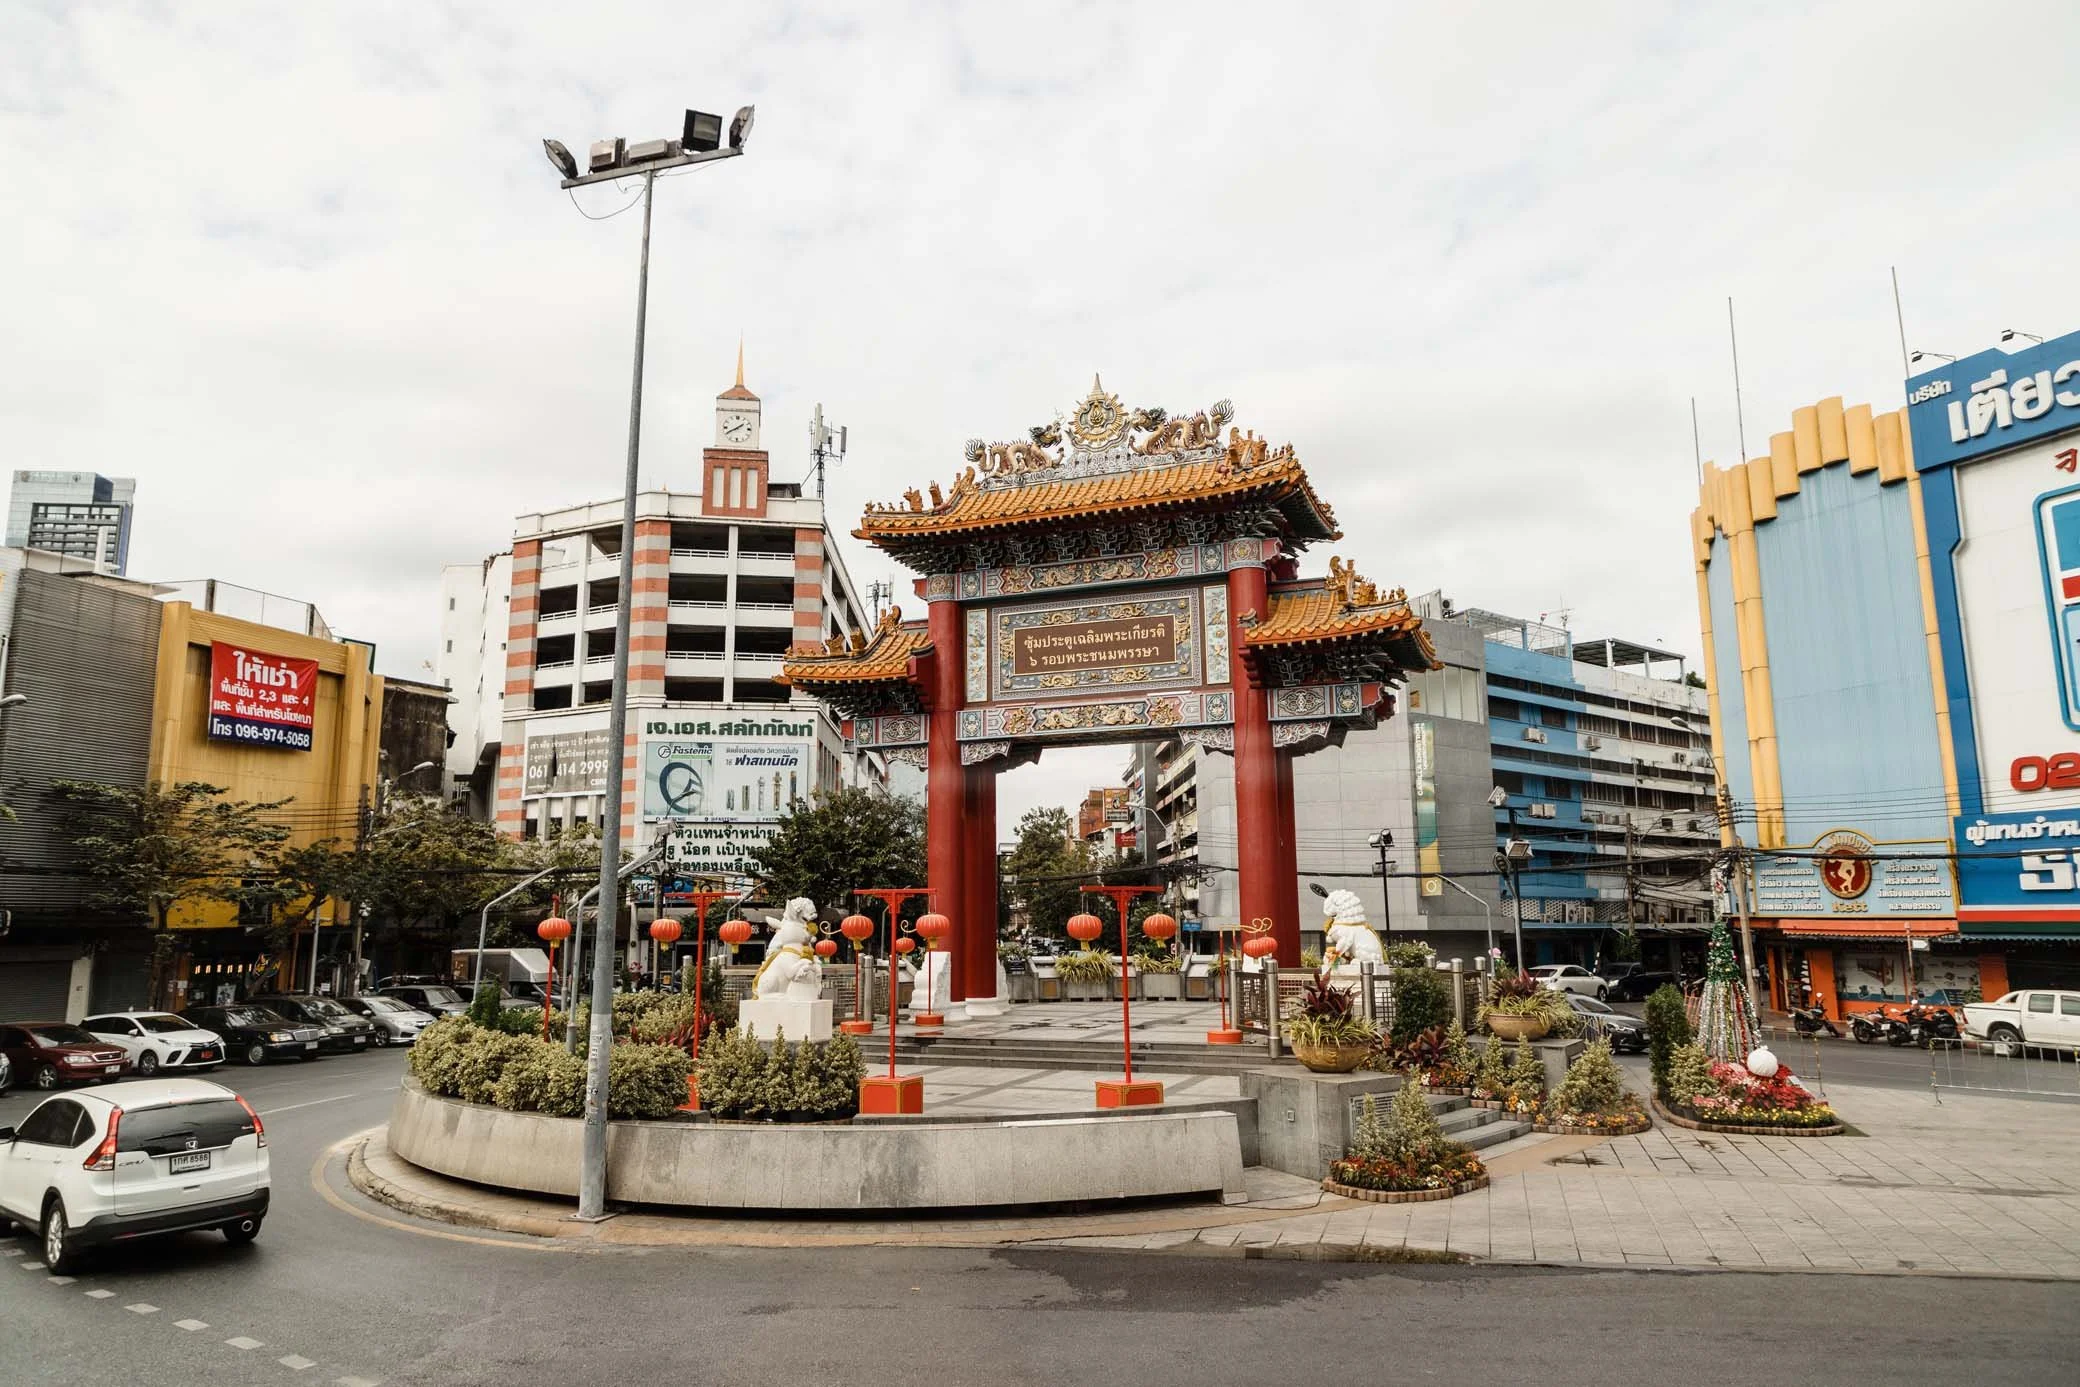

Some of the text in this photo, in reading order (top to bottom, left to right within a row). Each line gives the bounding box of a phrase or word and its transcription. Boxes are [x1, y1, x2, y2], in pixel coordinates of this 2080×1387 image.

[1024, 623, 1165, 652] ซุ้มประตูเฉลิมพระเกียรติ
[1042, 645, 1160, 666] รอบพระชนมพรรษา
[233, 650, 298, 689] ให้เช่า
[221, 677, 309, 706] พื้นที่ชั้น 2,3 และ 4
[213, 699, 231, 711] และ
[235, 723, 310, 747] 096-974-5058
[529, 764, 547, 778] 061
[580, 760, 608, 774] 2999
